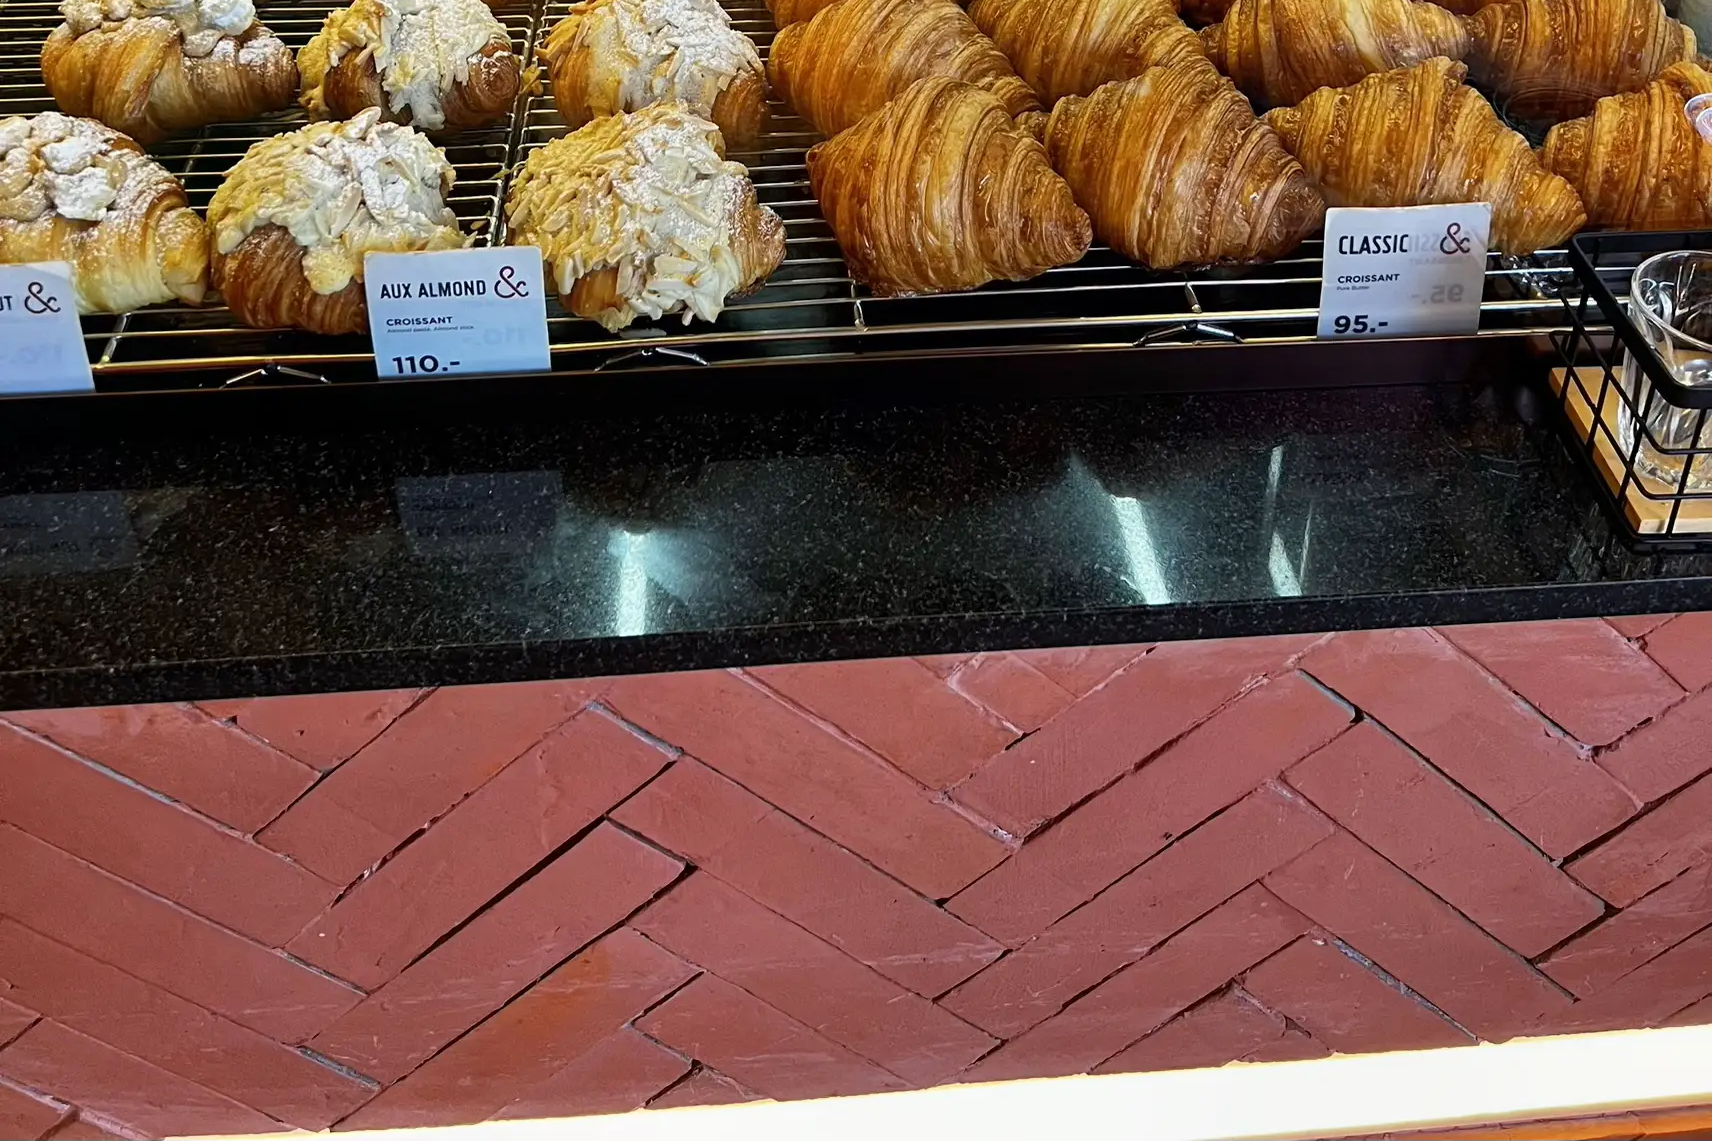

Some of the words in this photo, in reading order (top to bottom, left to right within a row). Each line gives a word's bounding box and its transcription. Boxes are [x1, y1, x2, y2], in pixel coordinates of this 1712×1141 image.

[1338, 234, 1409, 255] CLASSIC
[1440, 222, 1471, 255] &
[380, 283, 412, 299] AUX
[418, 280, 486, 298] ALMOND
[494, 265, 529, 299] &
[1337, 273, 1400, 284] CROISSANT
[24, 281, 61, 314] &
[386, 316, 453, 326] CROISSANT
[1333, 314, 1389, 334] 95.-
[392, 355, 460, 374] 110.-
